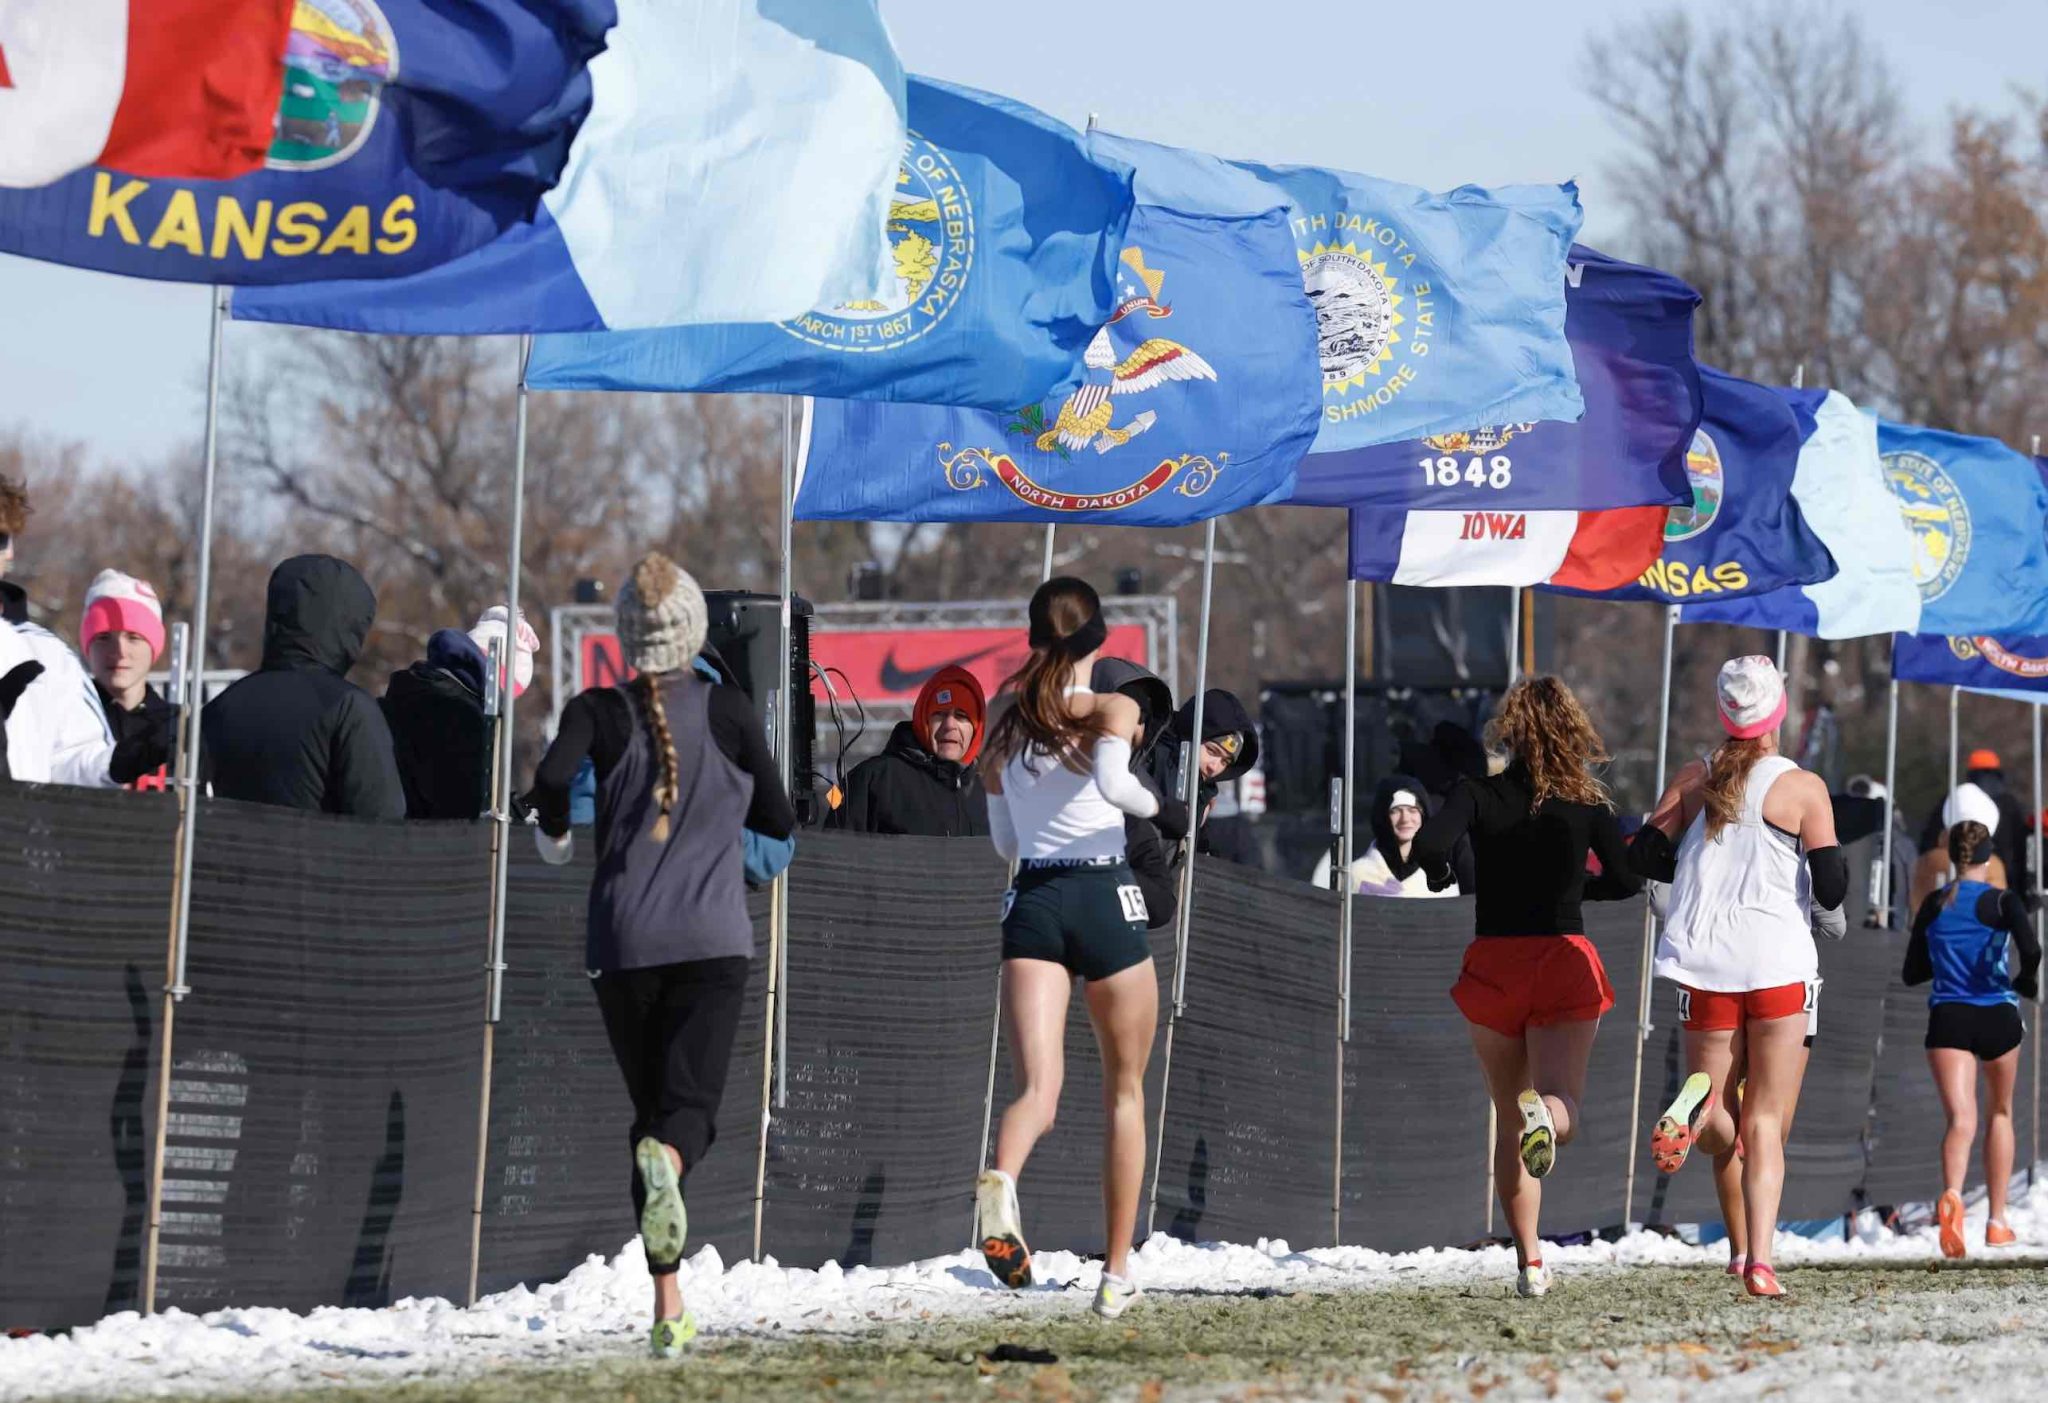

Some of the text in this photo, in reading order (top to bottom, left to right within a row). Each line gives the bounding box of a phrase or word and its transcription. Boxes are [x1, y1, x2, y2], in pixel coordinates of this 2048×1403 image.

[87, 173, 418, 260] KANSAS
[917, 154, 966, 317] OF NEBRASKA
[1334, 211, 1417, 270] DAKOTA
[1319, 253, 1357, 266] SOUTH
[1356, 262, 1389, 305] DAKOTA
[1120, 298, 1149, 314] UNUM
[876, 311, 913, 341] 1867
[1325, 280, 1435, 424] SHMORE STATE
[1360, 326, 1389, 366] SEAL
[1009, 474, 1150, 509] NORTH DAKOTA
[1418, 455, 1512, 490] 1848
[1459, 511, 1526, 540] IOWA
[1638, 558, 1749, 597] NSAS
